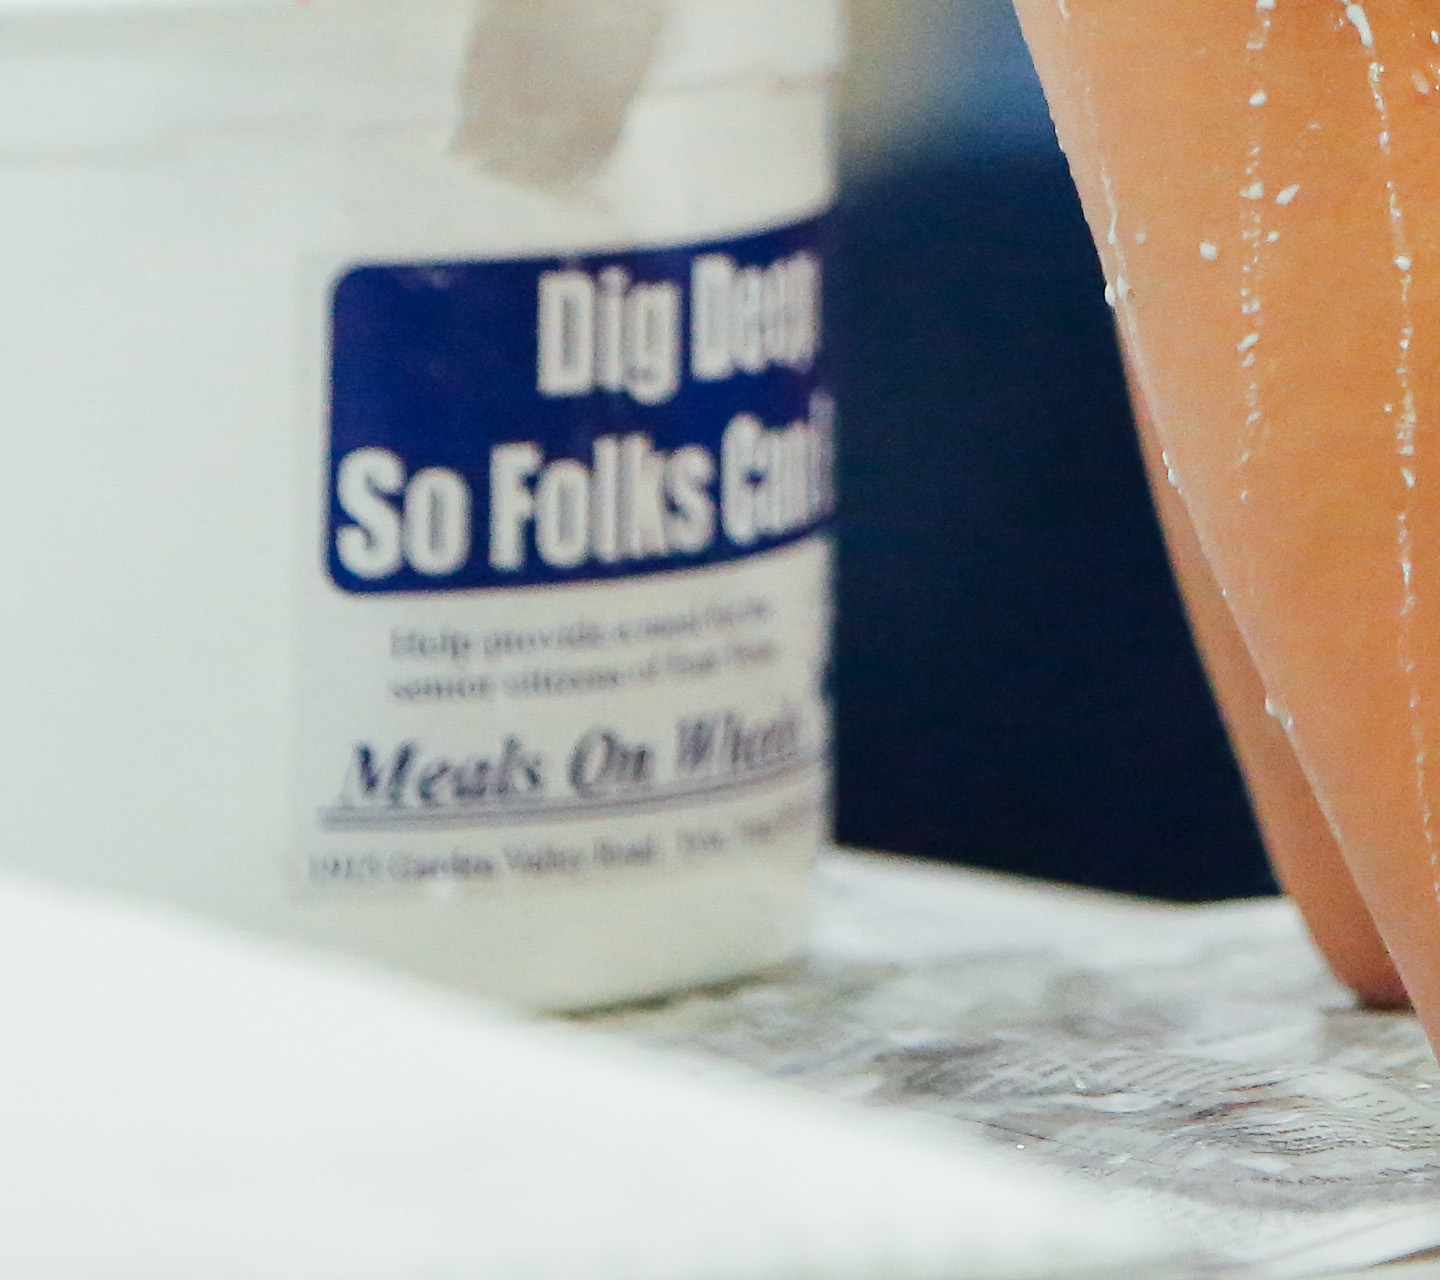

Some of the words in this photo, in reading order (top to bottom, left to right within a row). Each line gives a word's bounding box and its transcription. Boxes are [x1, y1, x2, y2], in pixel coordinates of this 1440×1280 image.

[537, 267, 682, 406] Dig
[335, 445, 474, 578] So
[487, 430, 716, 571] Folks
[340, 735, 546, 804] Meals
[566, 726, 656, 796] On
